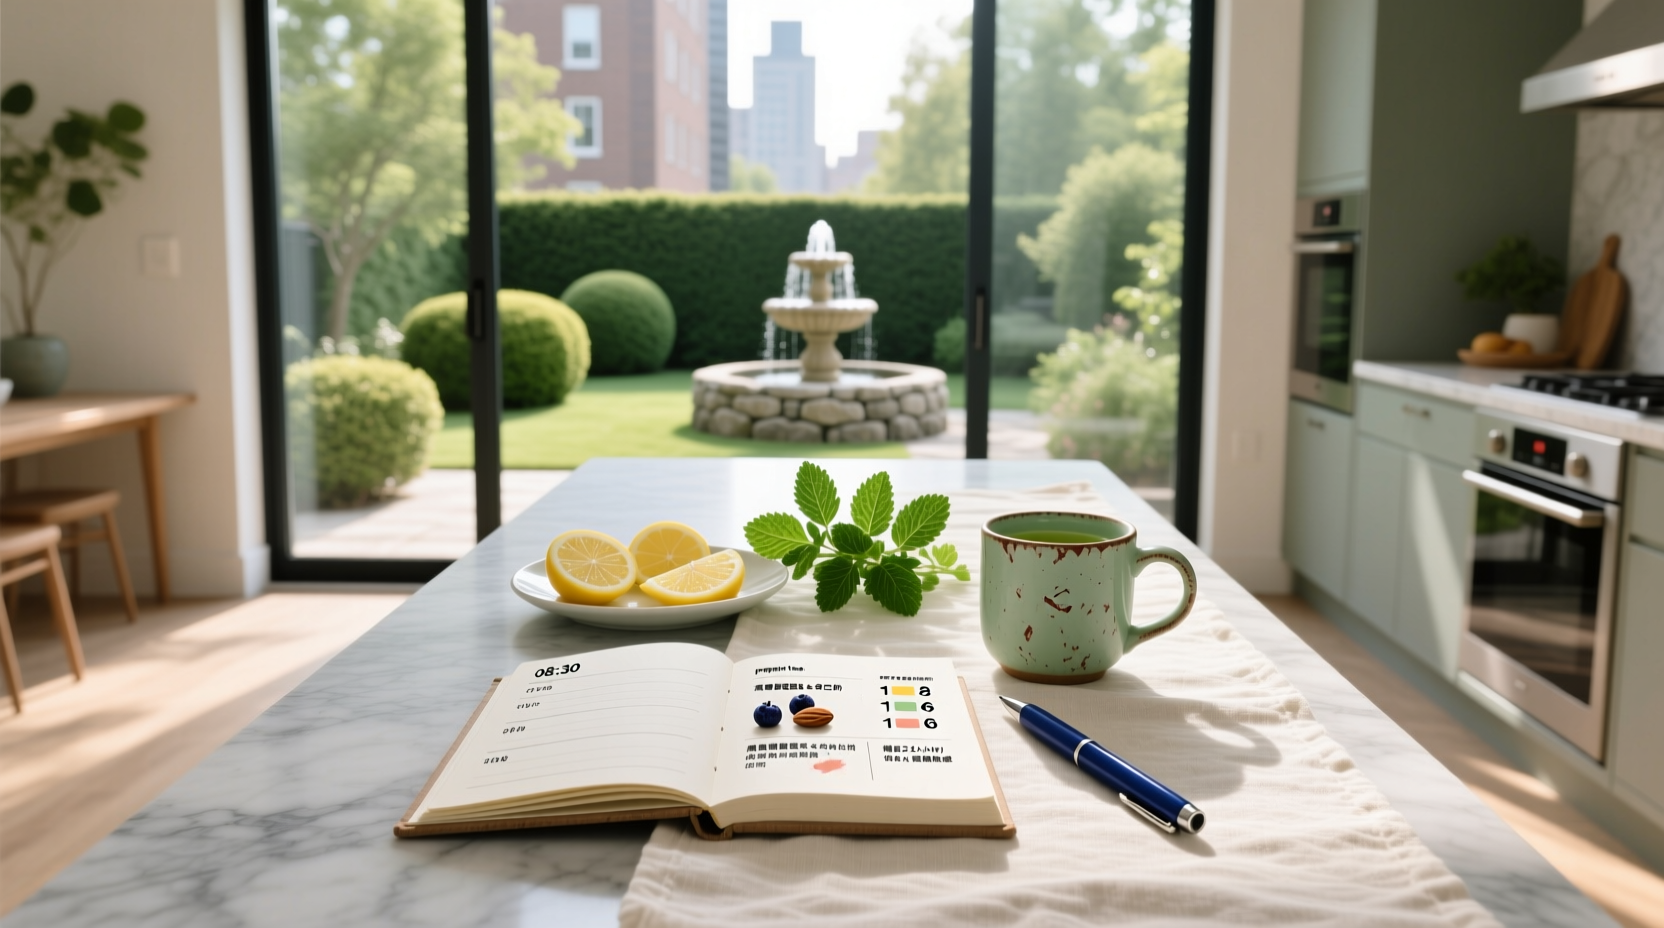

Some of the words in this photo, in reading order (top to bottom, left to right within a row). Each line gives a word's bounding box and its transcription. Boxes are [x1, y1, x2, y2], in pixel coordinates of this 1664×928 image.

[534, 662, 581, 678] 08:30
[921, 702, 934, 712] 6
[924, 718, 938, 729] 6
